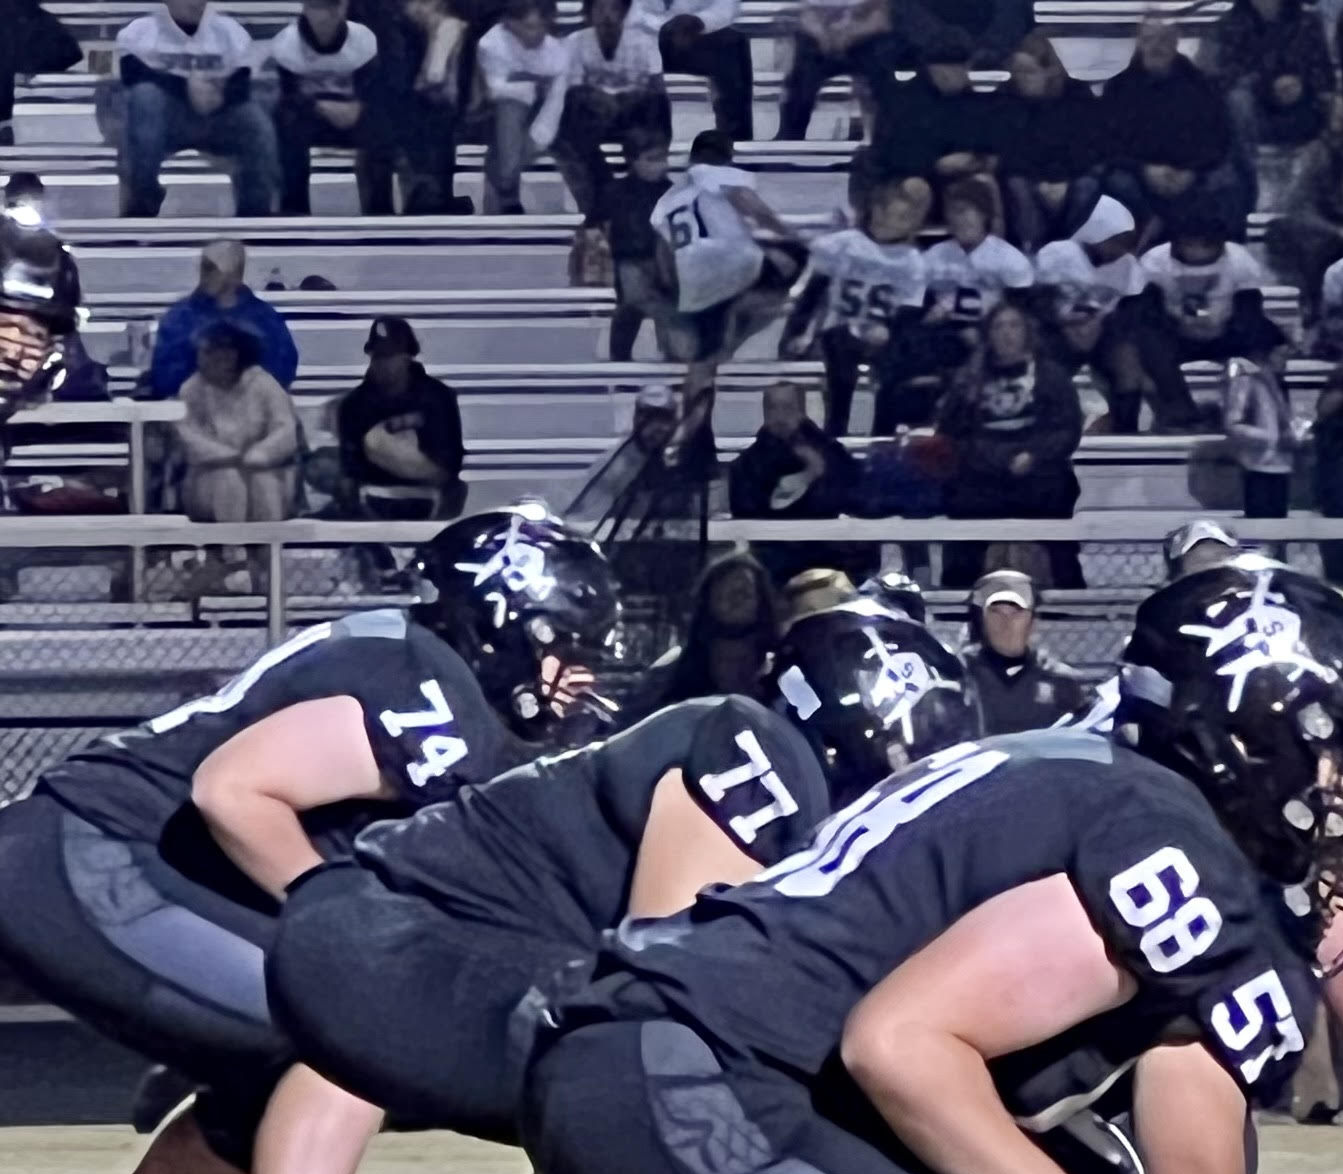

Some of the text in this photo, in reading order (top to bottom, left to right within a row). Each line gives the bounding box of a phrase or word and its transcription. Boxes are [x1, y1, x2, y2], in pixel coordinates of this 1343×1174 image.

[666, 197, 709, 249] 61
[379, 678, 470, 787] 74
[699, 729, 799, 845] 77
[1109, 846, 1223, 973] 68
